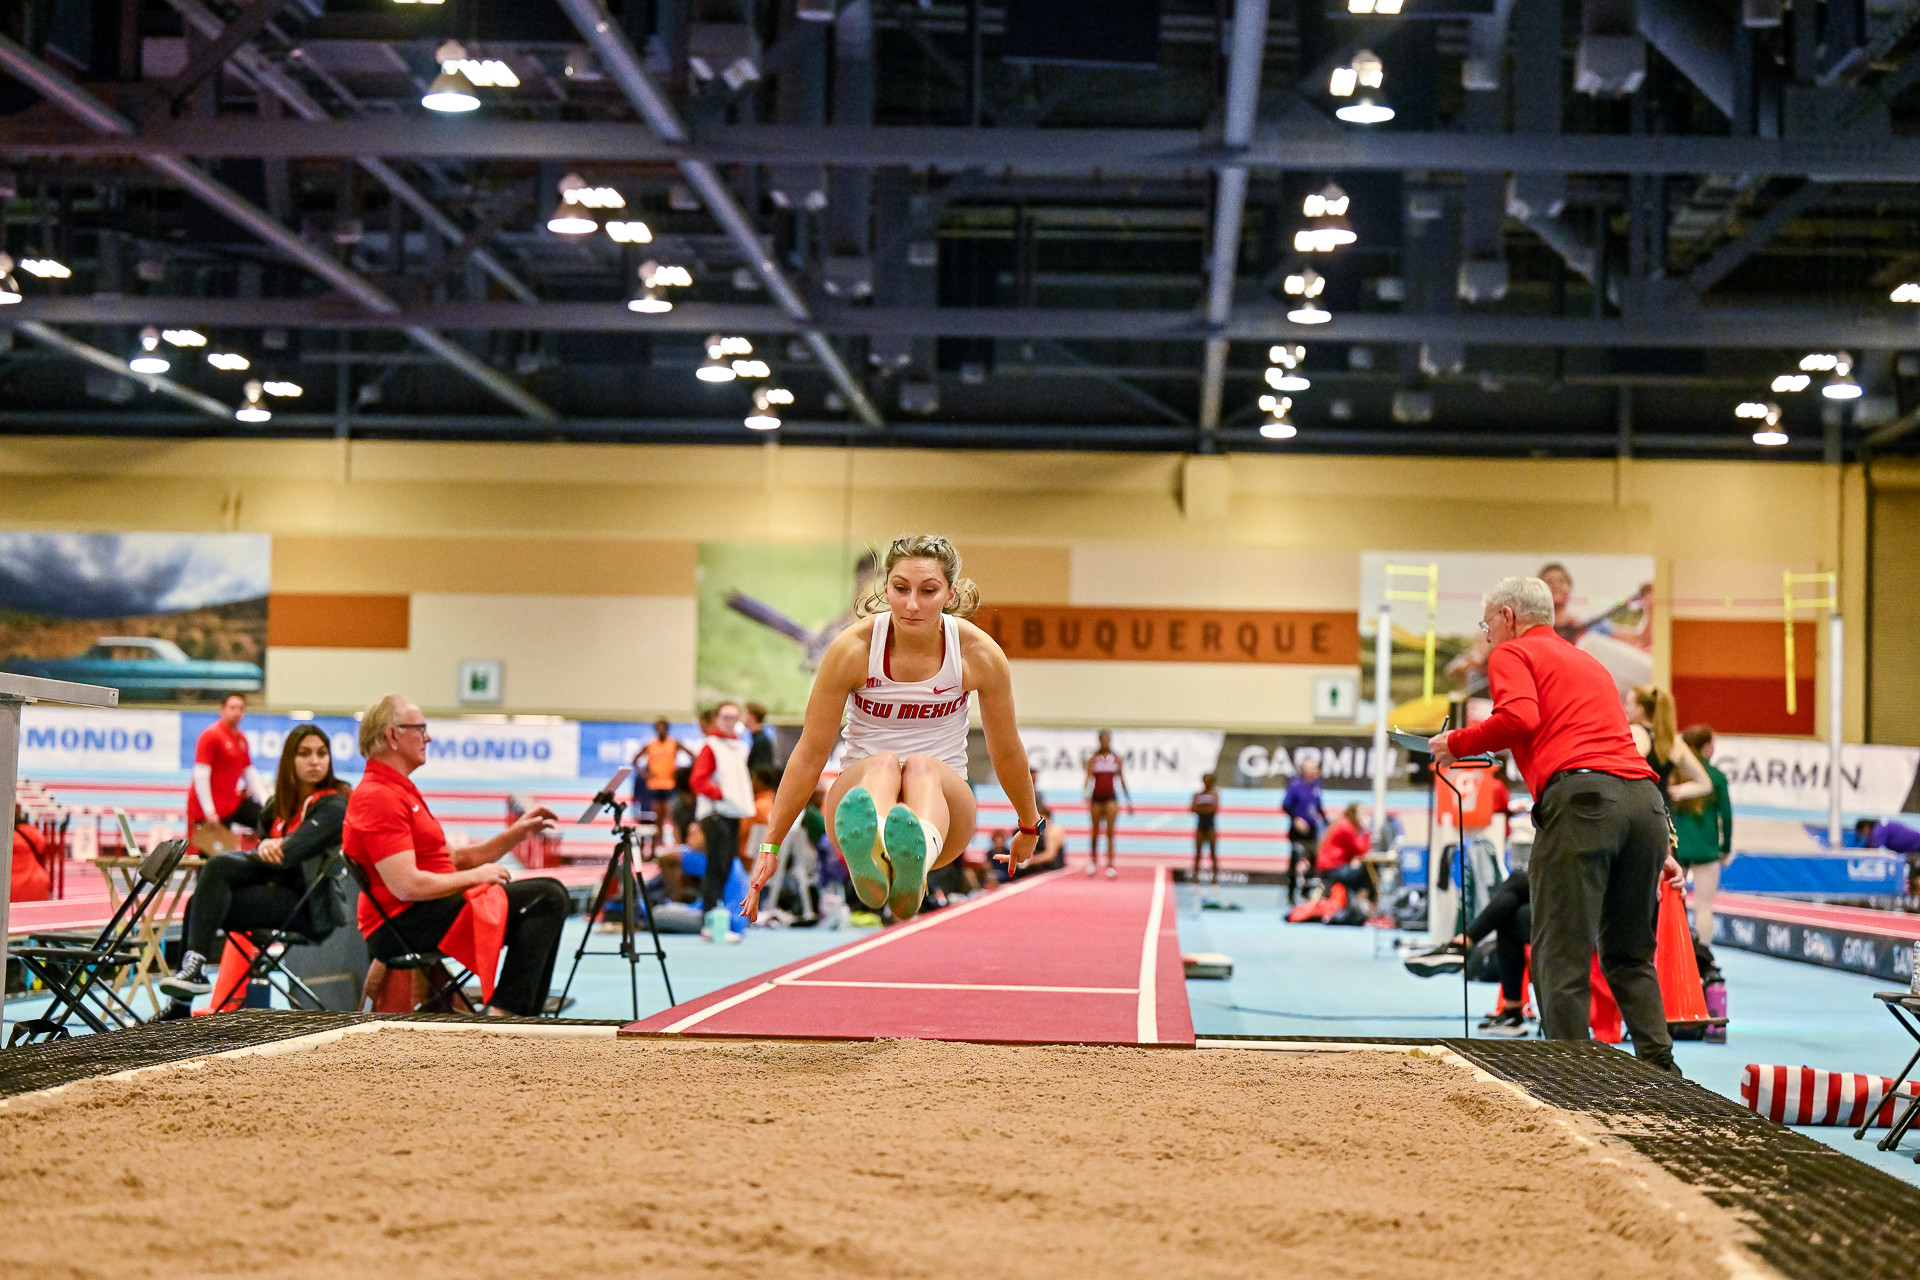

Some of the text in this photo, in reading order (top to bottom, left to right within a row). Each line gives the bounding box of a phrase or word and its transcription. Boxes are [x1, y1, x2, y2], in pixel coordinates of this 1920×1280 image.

[991, 616, 1331, 656] LBUQUERQUE
[854, 693, 893, 719] NEW
[27, 727, 153, 751] MONDO
[428, 737, 551, 760] MONDO
